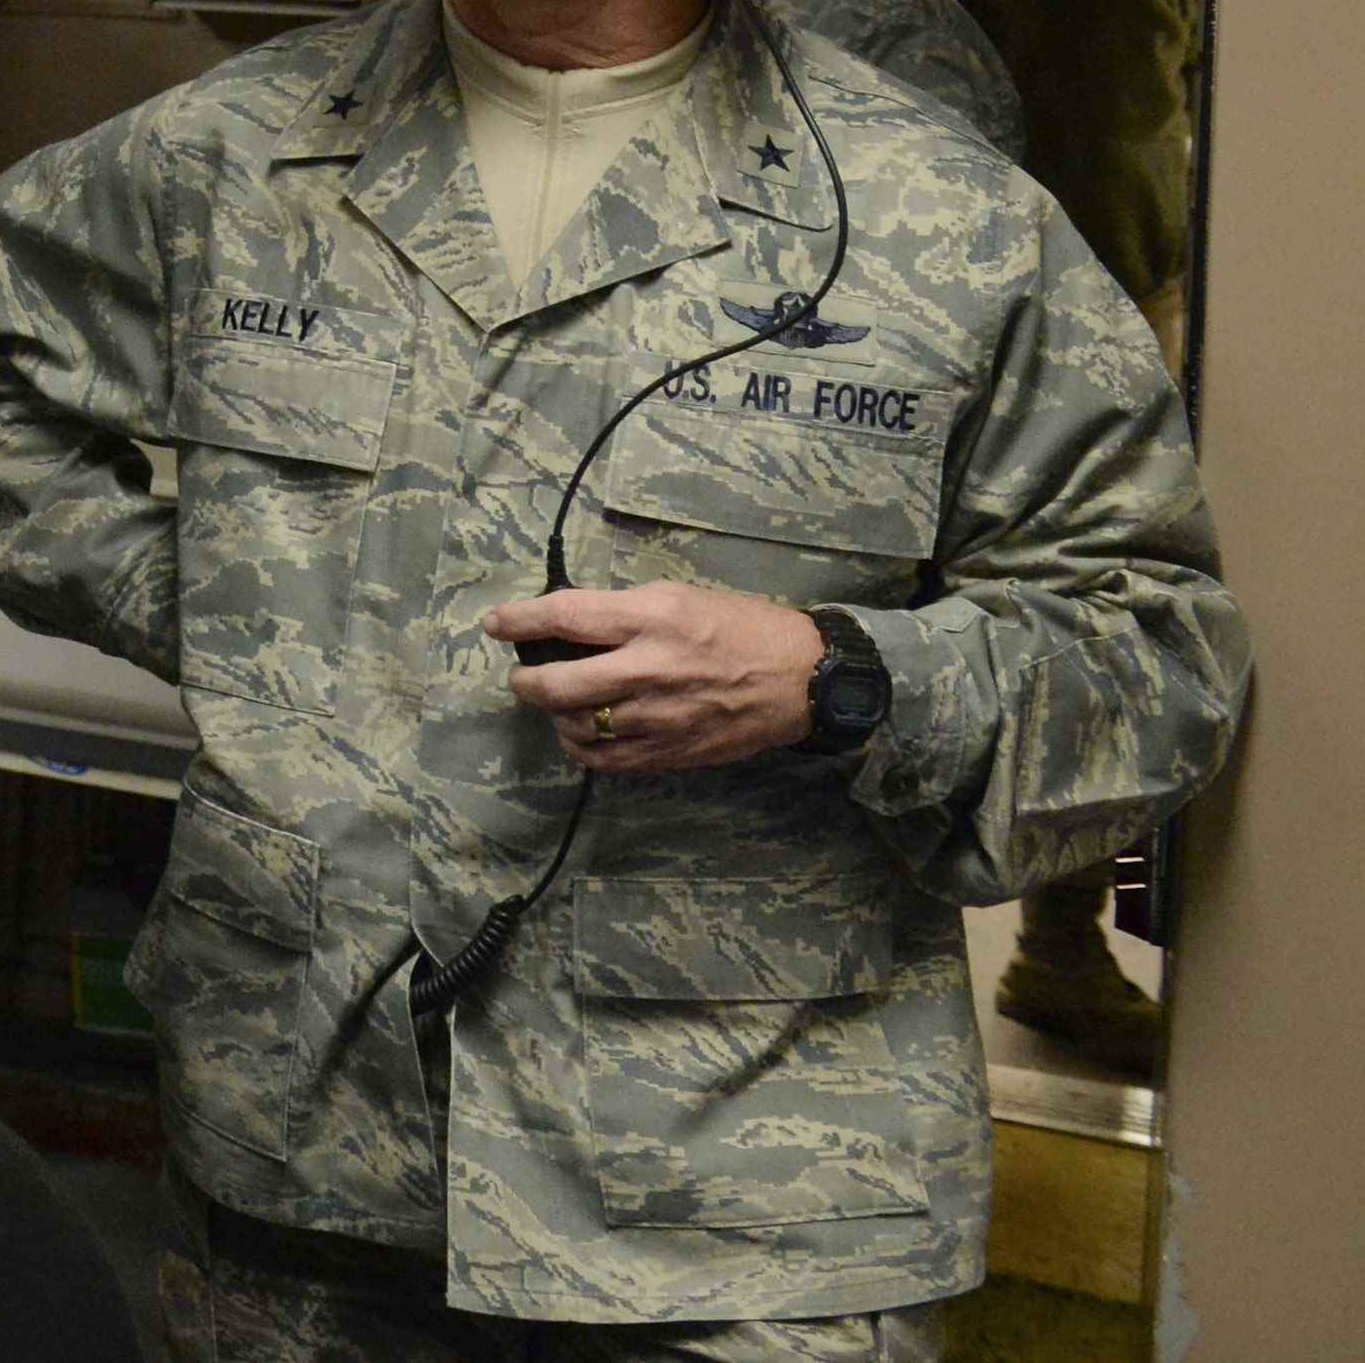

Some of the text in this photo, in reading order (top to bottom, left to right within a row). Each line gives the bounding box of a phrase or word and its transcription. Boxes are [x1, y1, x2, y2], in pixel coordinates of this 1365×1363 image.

[221, 298, 320, 342] KELLY
[662, 359, 920, 431] U.S. AIR FORCE
